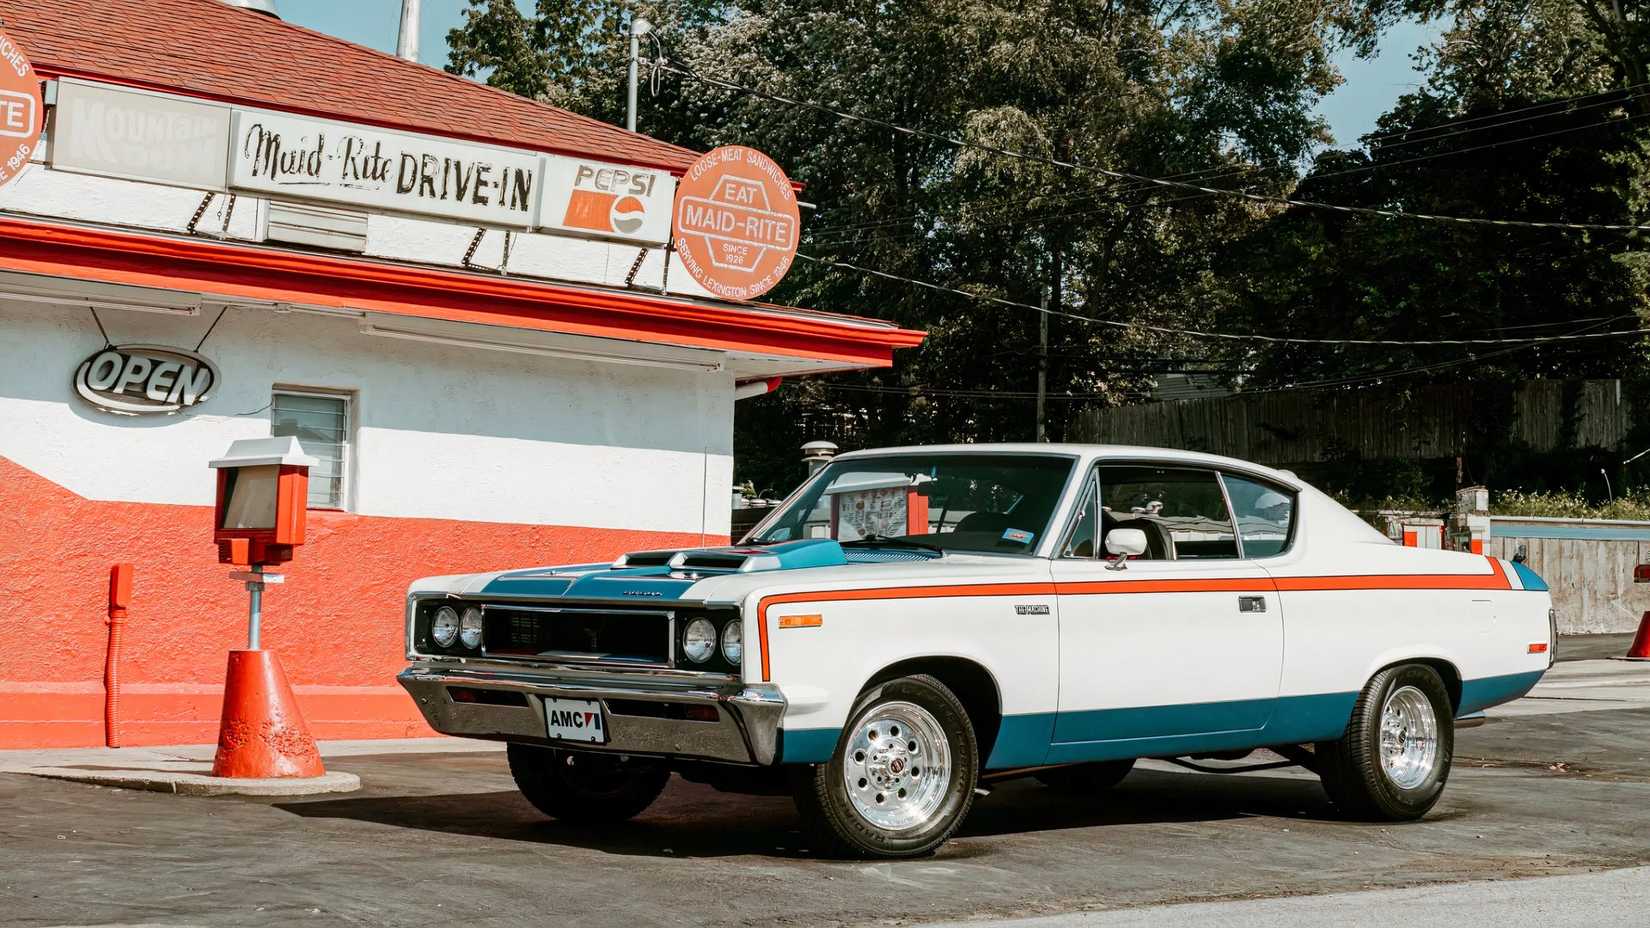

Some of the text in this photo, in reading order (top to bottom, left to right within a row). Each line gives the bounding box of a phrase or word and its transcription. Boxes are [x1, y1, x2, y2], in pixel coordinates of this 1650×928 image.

[0, 35, 30, 77] ICHES
[7, 144, 31, 171] 1946
[690, 149, 793, 200] LOOSE-MEAT SANDWICHES
[396, 151, 533, 213] DRIVE-IN
[575, 165, 657, 198] PEPSI
[725, 183, 758, 204] EAT
[685, 204, 789, 242] MAID-RITE
[722, 243, 749, 255] SINCE
[725, 254, 745, 265] 1926
[678, 238, 704, 279] SERVING
[703, 276, 747, 297] LEXINGTON
[751, 275, 774, 294] SINCE
[87, 351, 209, 406] OPEN
[551, 710, 584, 729] AMC
